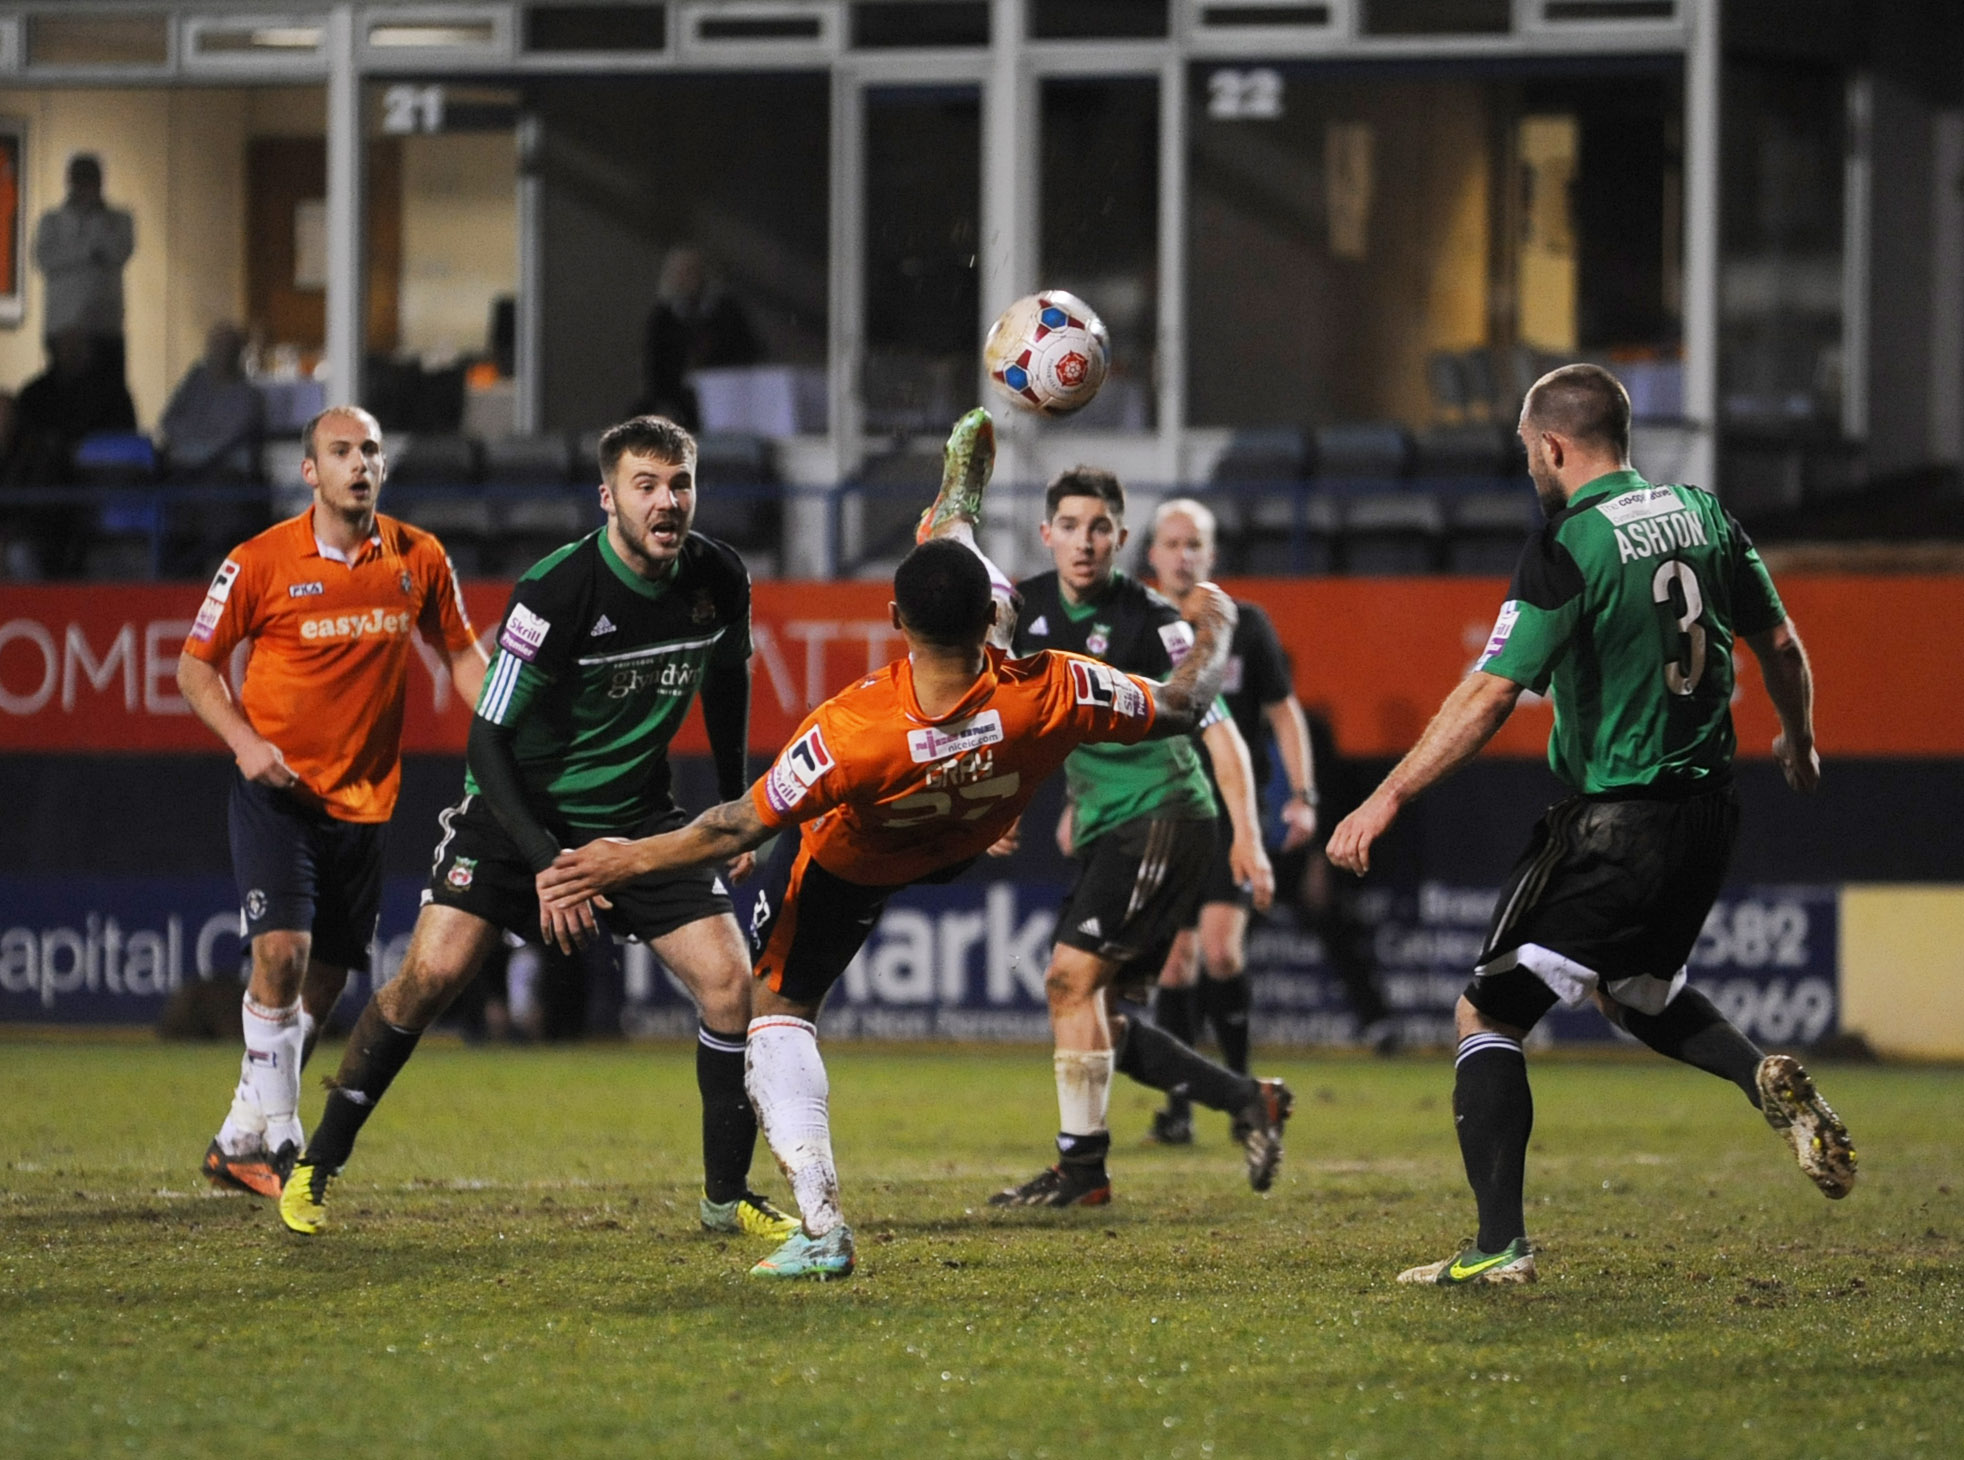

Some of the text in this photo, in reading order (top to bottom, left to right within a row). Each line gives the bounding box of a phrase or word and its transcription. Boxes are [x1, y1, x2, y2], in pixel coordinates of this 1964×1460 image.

[383, 83, 443, 134] 21
[1613, 510, 1708, 565] ASHTON
[300, 607, 411, 641] easyJet
[509, 616, 542, 644] Skrill
[1652, 559, 1707, 697] 3
[948, 732, 999, 753] niceic.com
